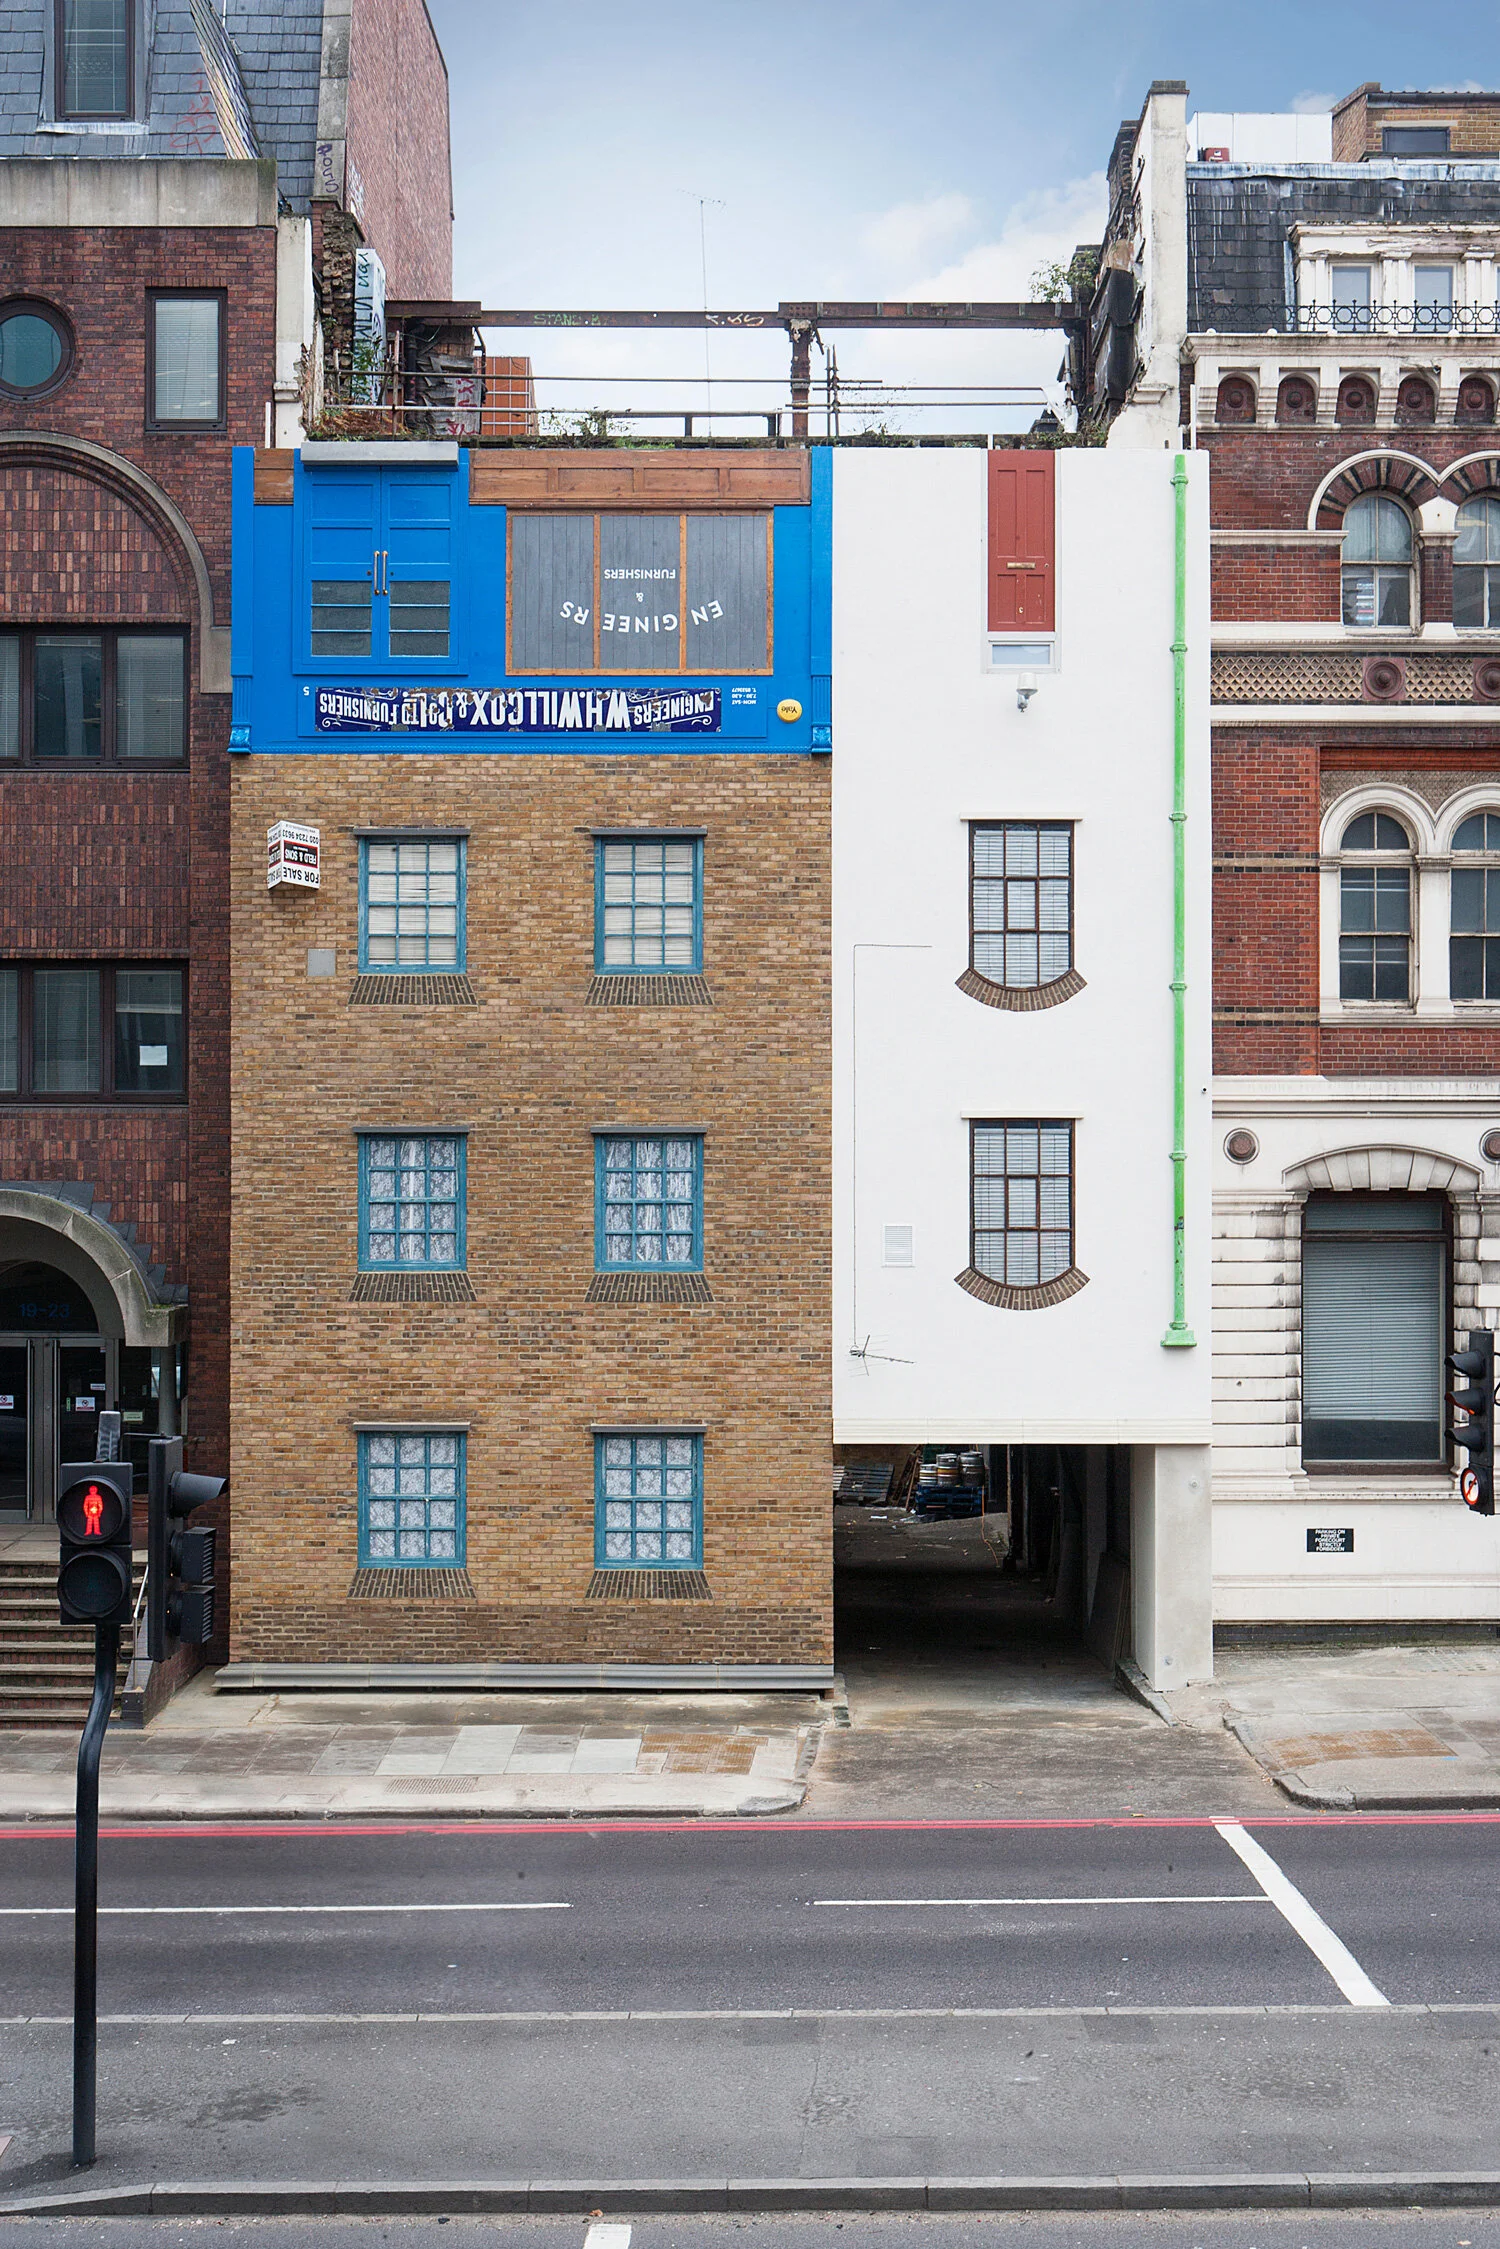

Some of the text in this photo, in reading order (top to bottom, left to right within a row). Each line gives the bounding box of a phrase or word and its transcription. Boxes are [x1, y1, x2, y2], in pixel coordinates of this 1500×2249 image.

[604, 569, 676, 580] FURNISHERS
[636, 592, 644, 602] &
[303, 686, 310, 696] 5
[319, 692, 399, 725] FURNISHERS
[634, 690, 714, 725] ENGINEERS
[781, 705, 798, 714] Yale
[285, 849, 299, 861] SONS
[299, 851, 304, 862] &
[283, 866, 302, 880] SALE
[304, 871, 319, 884] FOR
[19, 1303, 71, 1318] 19-23
